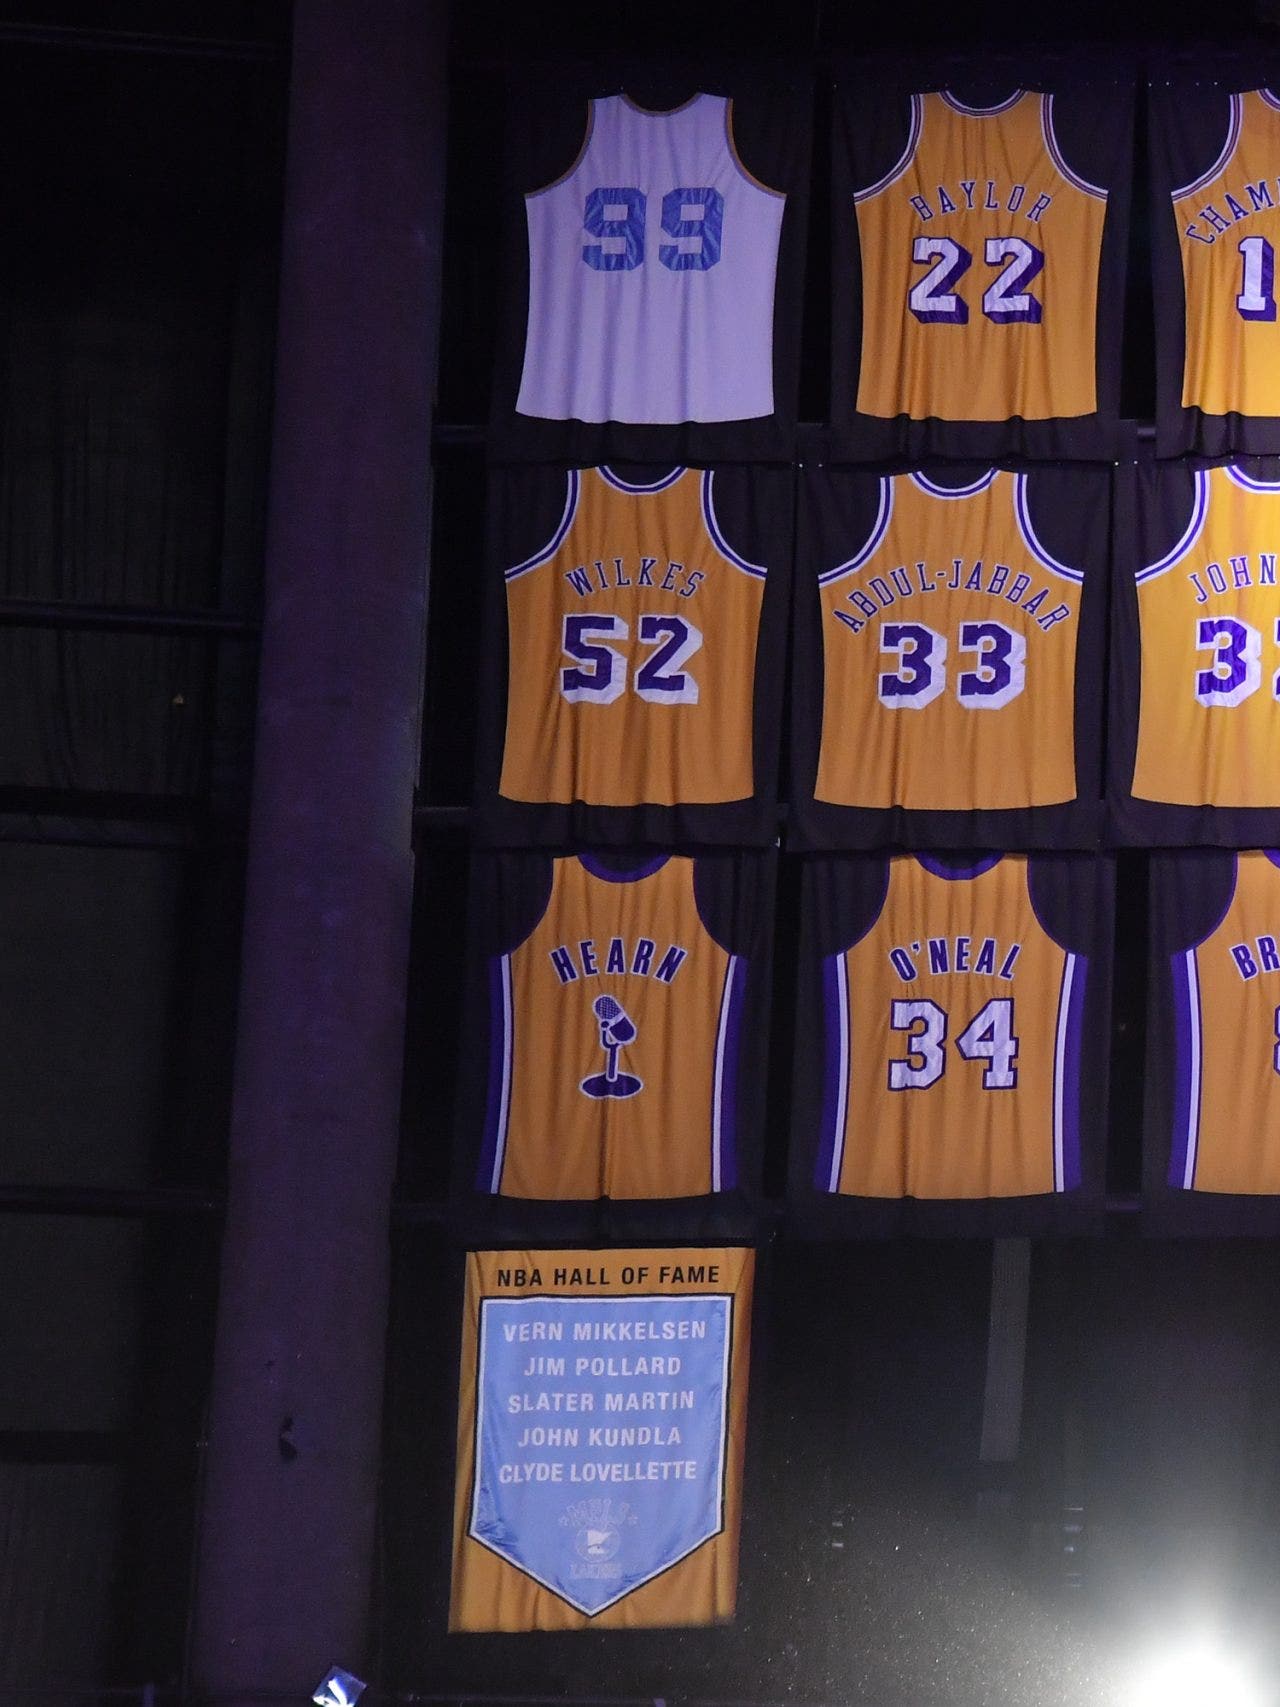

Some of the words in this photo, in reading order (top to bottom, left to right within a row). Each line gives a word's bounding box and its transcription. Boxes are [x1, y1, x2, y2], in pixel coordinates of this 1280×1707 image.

[910, 180, 1052, 223] BAYLOR
[582, 187, 724, 271] 99
[908, 236, 1044, 325] 22
[565, 558, 705, 599] WILKES
[831, 559, 1073, 633] ABDUL-JABBAR
[560, 613, 703, 705] 52
[878, 619, 1026, 710] 33
[549, 937, 688, 984] HEARN
[888, 936, 1023, 983] O'NEAL
[888, 997, 1019, 1091] 34
[497, 1268, 543, 1288] NBA
[553, 1267, 610, 1286] HALL
[621, 1266, 649, 1284] OF
[659, 1265, 721, 1284] FAME
[503, 1321, 563, 1342] VERN
[573, 1320, 707, 1341] MIKKELSEN
[524, 1356, 565, 1376] JIM
[576, 1356, 681, 1376] POLLARD
[508, 1393, 595, 1414] SLATER
[605, 1390, 694, 1412] MARTIN
[518, 1427, 579, 1448] JOHN
[589, 1426, 681, 1446] KUNDLA
[499, 1463, 563, 1484] CLYDE
[571, 1460, 698, 1482] LOVELLETTE
